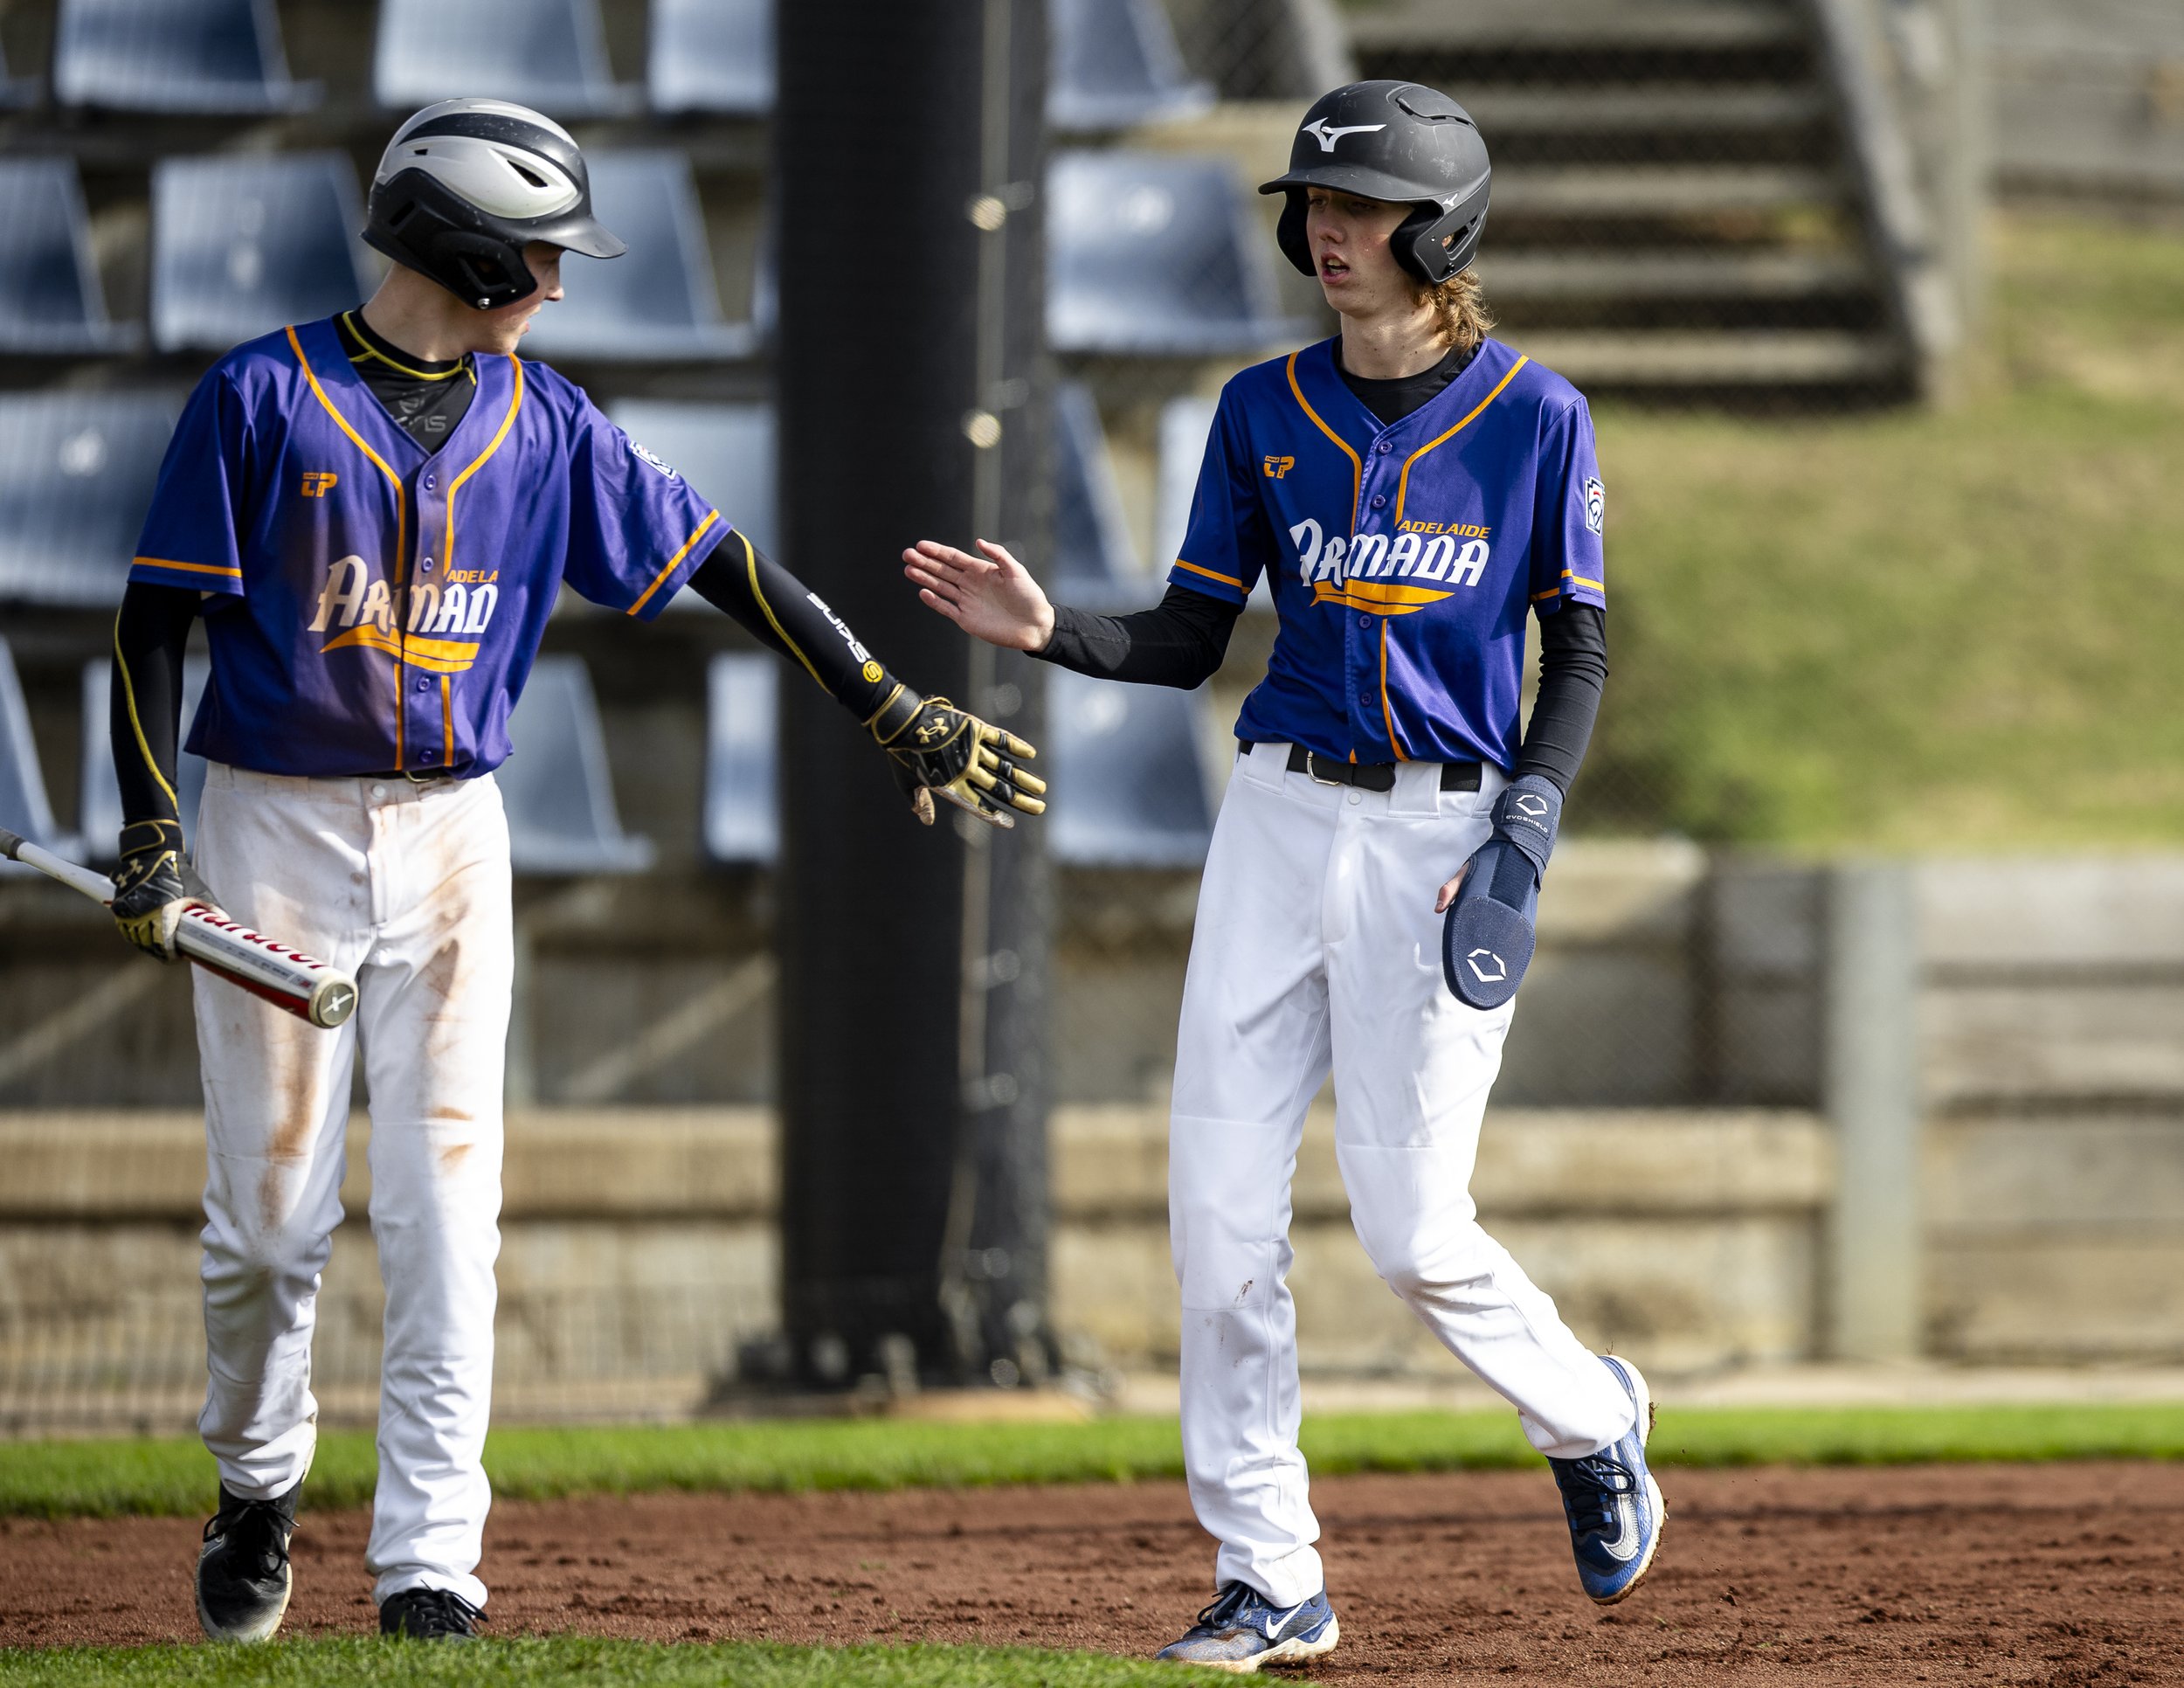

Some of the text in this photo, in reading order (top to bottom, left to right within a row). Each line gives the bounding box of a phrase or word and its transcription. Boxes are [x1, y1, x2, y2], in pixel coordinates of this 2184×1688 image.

[1398, 520, 1491, 538] ADELAIDE
[1289, 518, 1490, 587] ARMADA
[307, 555, 499, 633] ARMAD
[446, 570, 499, 584] ADELA
